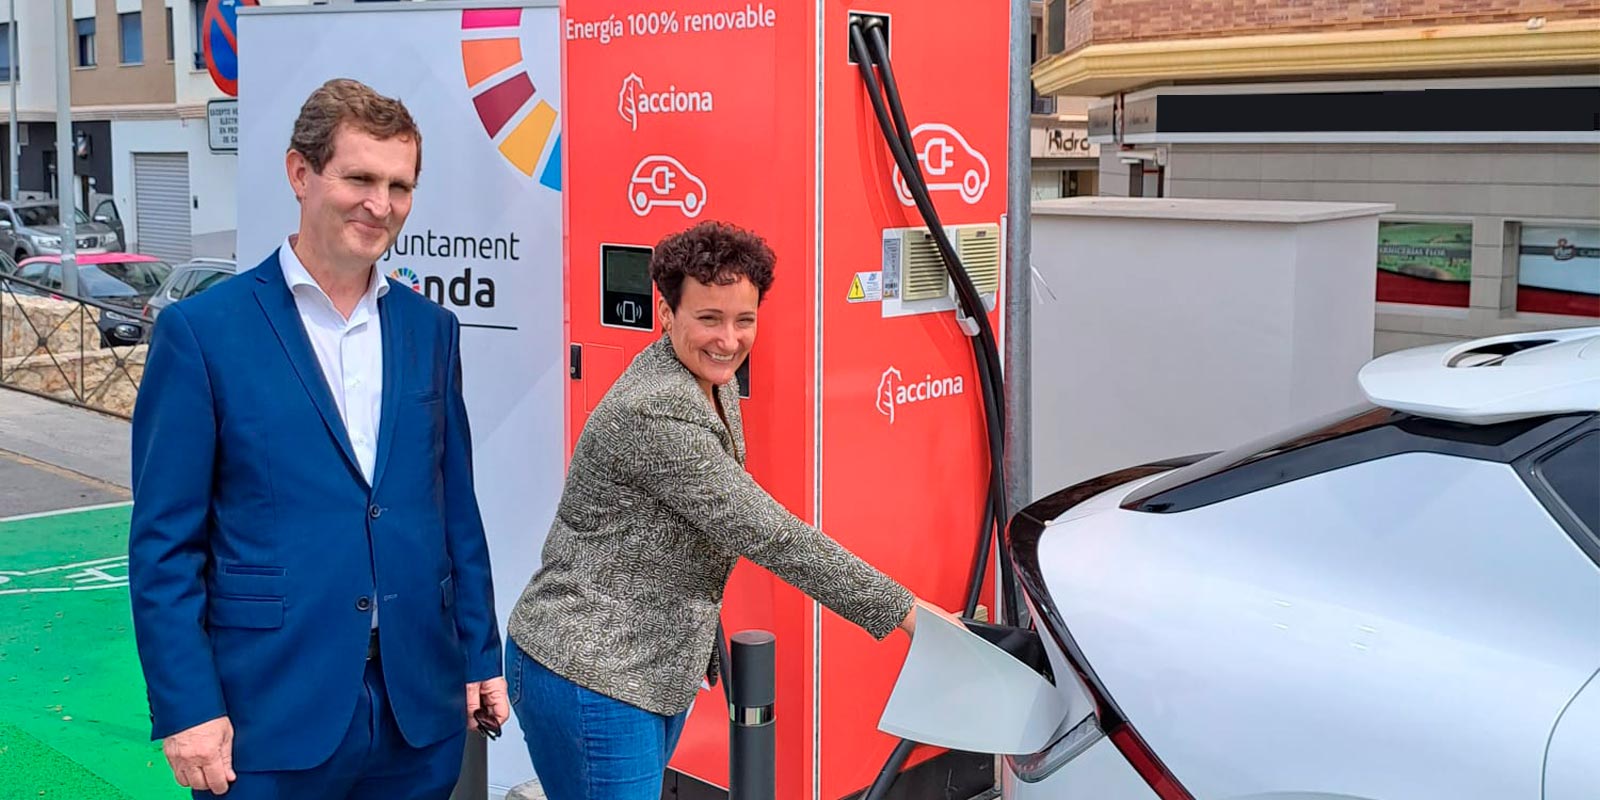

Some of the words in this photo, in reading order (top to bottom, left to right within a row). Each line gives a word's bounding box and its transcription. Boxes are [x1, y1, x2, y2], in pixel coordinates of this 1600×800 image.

[566, 14, 624, 44] Energía
[627, 11, 679, 36] 100%
[684, 3, 776, 32] renovable
[638, 85, 713, 113] acciona
[896, 374, 963, 404] acciona
